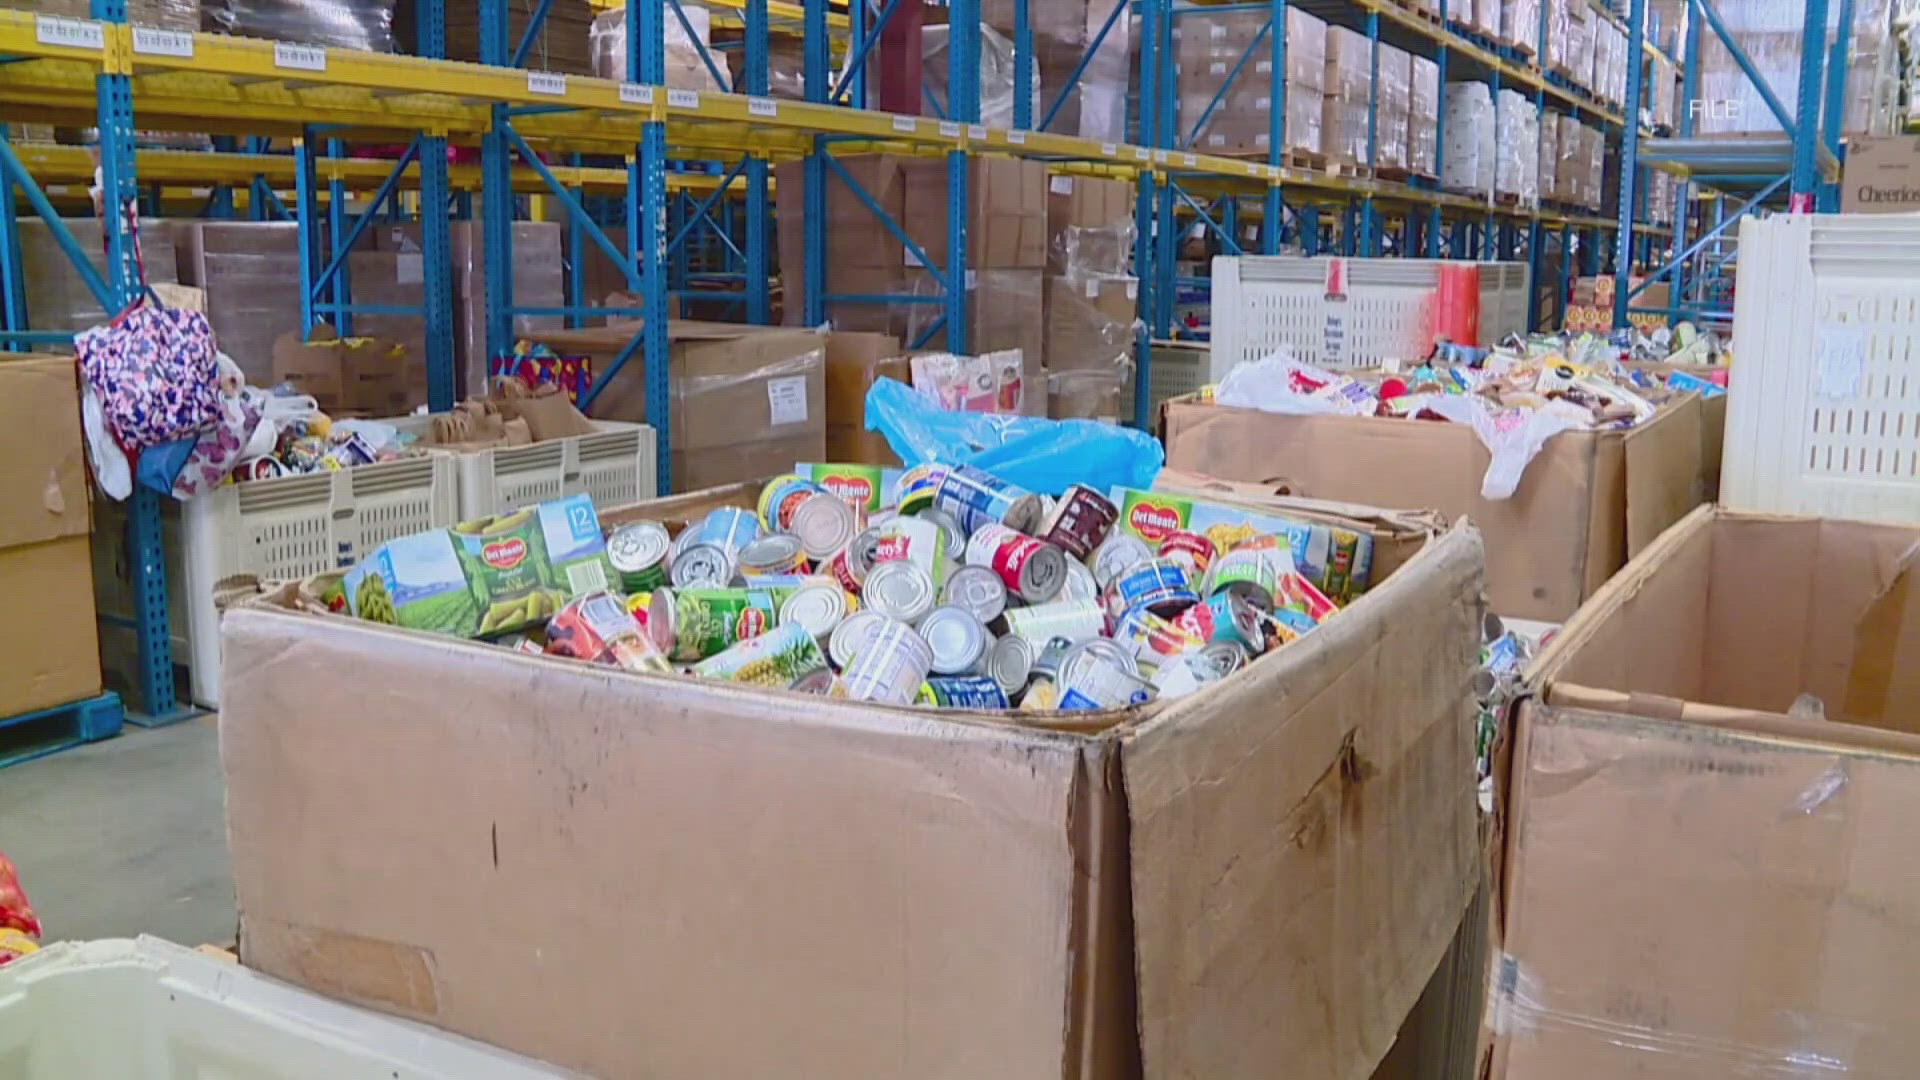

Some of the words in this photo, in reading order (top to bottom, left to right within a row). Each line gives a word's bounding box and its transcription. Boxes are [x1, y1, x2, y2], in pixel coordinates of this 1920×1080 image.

[839, 483, 869, 497] Monte
[570, 507, 591, 528] 12
[1132, 508, 1148, 525] Del
[1147, 511, 1177, 529] Monte
[499, 543, 524, 558] Monte
